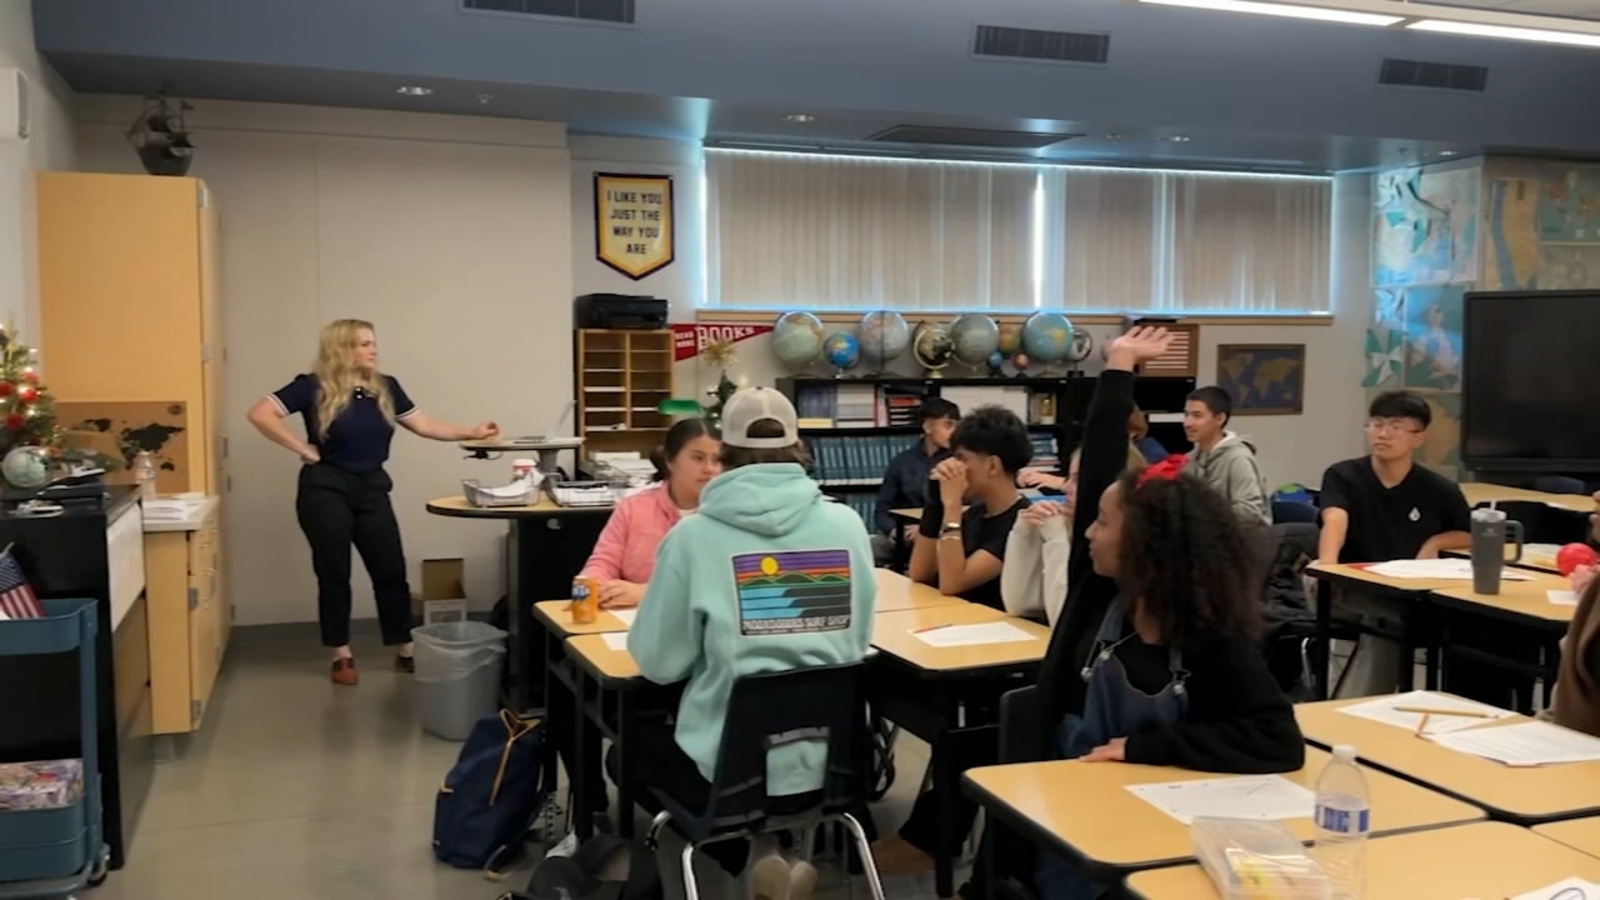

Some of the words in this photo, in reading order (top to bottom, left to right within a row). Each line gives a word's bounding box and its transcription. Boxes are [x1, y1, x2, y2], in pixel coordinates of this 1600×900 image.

[614, 191, 637, 203] LIKE
[641, 192, 662, 205] YOU
[610, 209, 636, 221] JUST
[641, 210, 660, 221] THE
[613, 226, 633, 237] WAY
[638, 227, 660, 239] YOU
[626, 243, 647, 255] ARE
[695, 326, 755, 351] BOOKS
